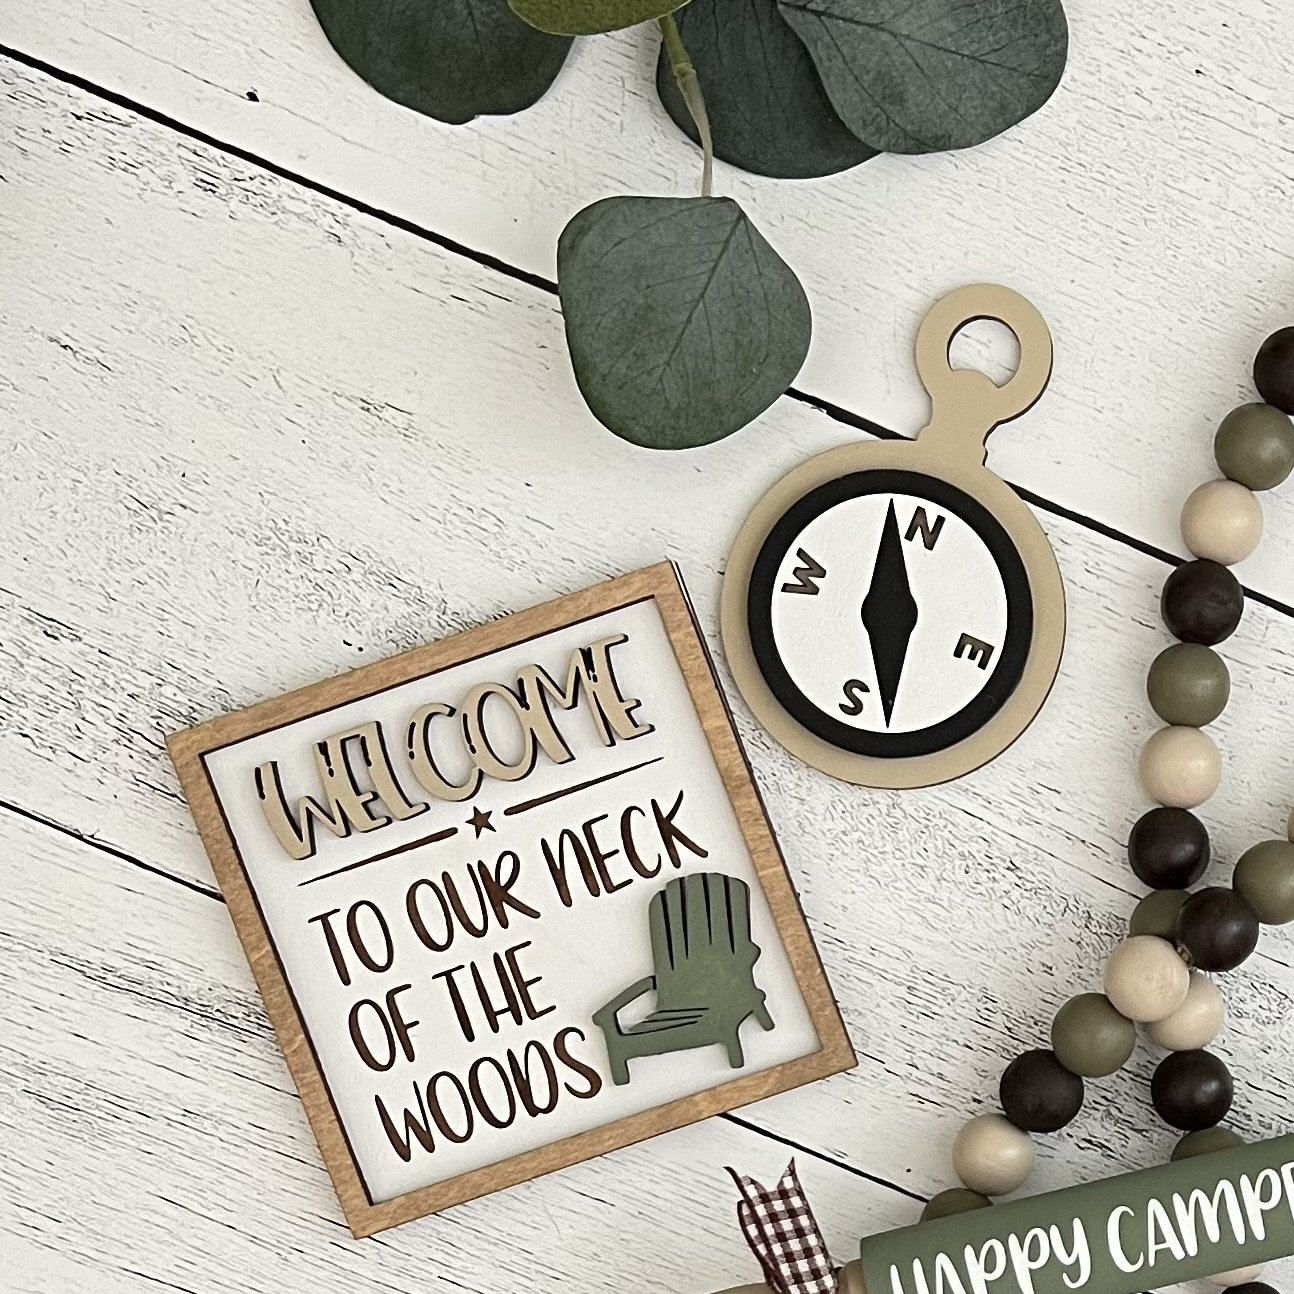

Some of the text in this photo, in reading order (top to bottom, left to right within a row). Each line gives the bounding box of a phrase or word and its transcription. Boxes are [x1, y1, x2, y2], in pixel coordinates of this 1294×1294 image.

[780, 547, 827, 596] W
[904, 505, 946, 551] N
[952, 632, 995, 671] E
[838, 678, 871, 717] S
[254, 632, 656, 861] WELCOME
[307, 789, 709, 986] TO OUR NECK
[347, 940, 557, 1073] OF THE
[374, 1026, 602, 1163] WOODS
